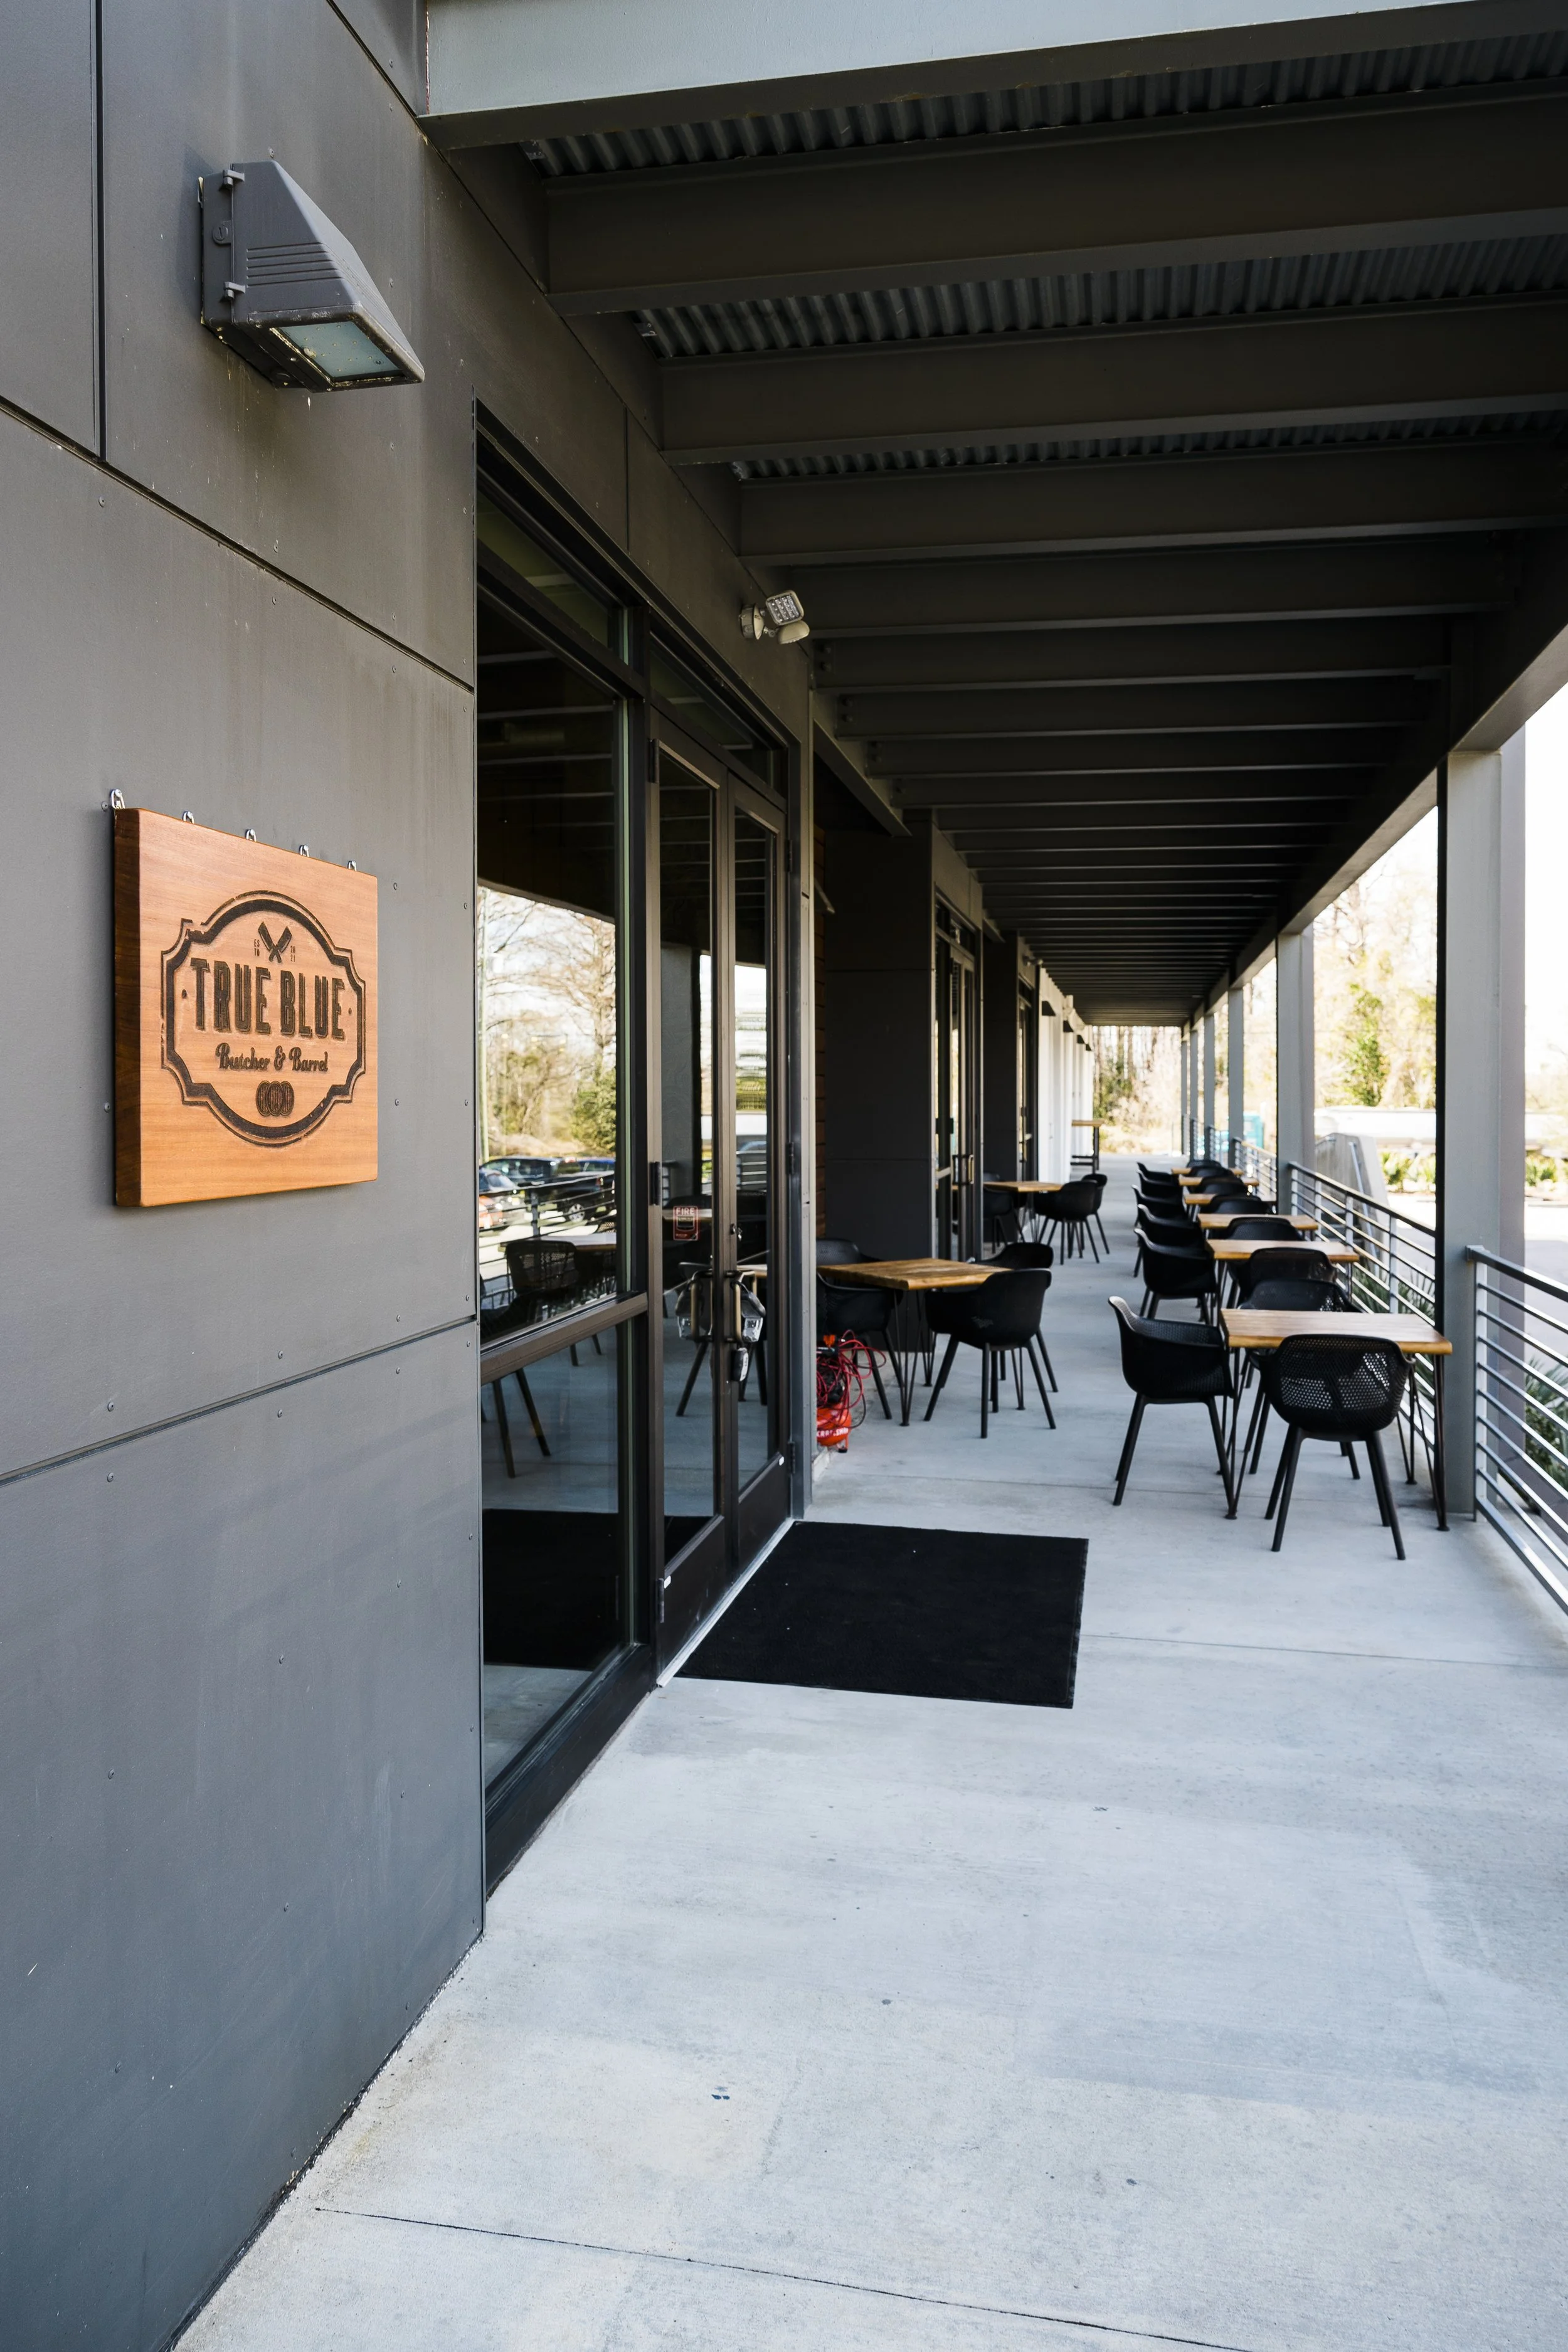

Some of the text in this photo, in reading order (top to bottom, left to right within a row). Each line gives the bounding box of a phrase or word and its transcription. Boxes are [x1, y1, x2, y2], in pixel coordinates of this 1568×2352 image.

[190, 957, 345, 1040] TRUE BLUE
[215, 1042, 328, 1072] Butcher & Barrel
[676, 1207, 694, 1216] FIRE
